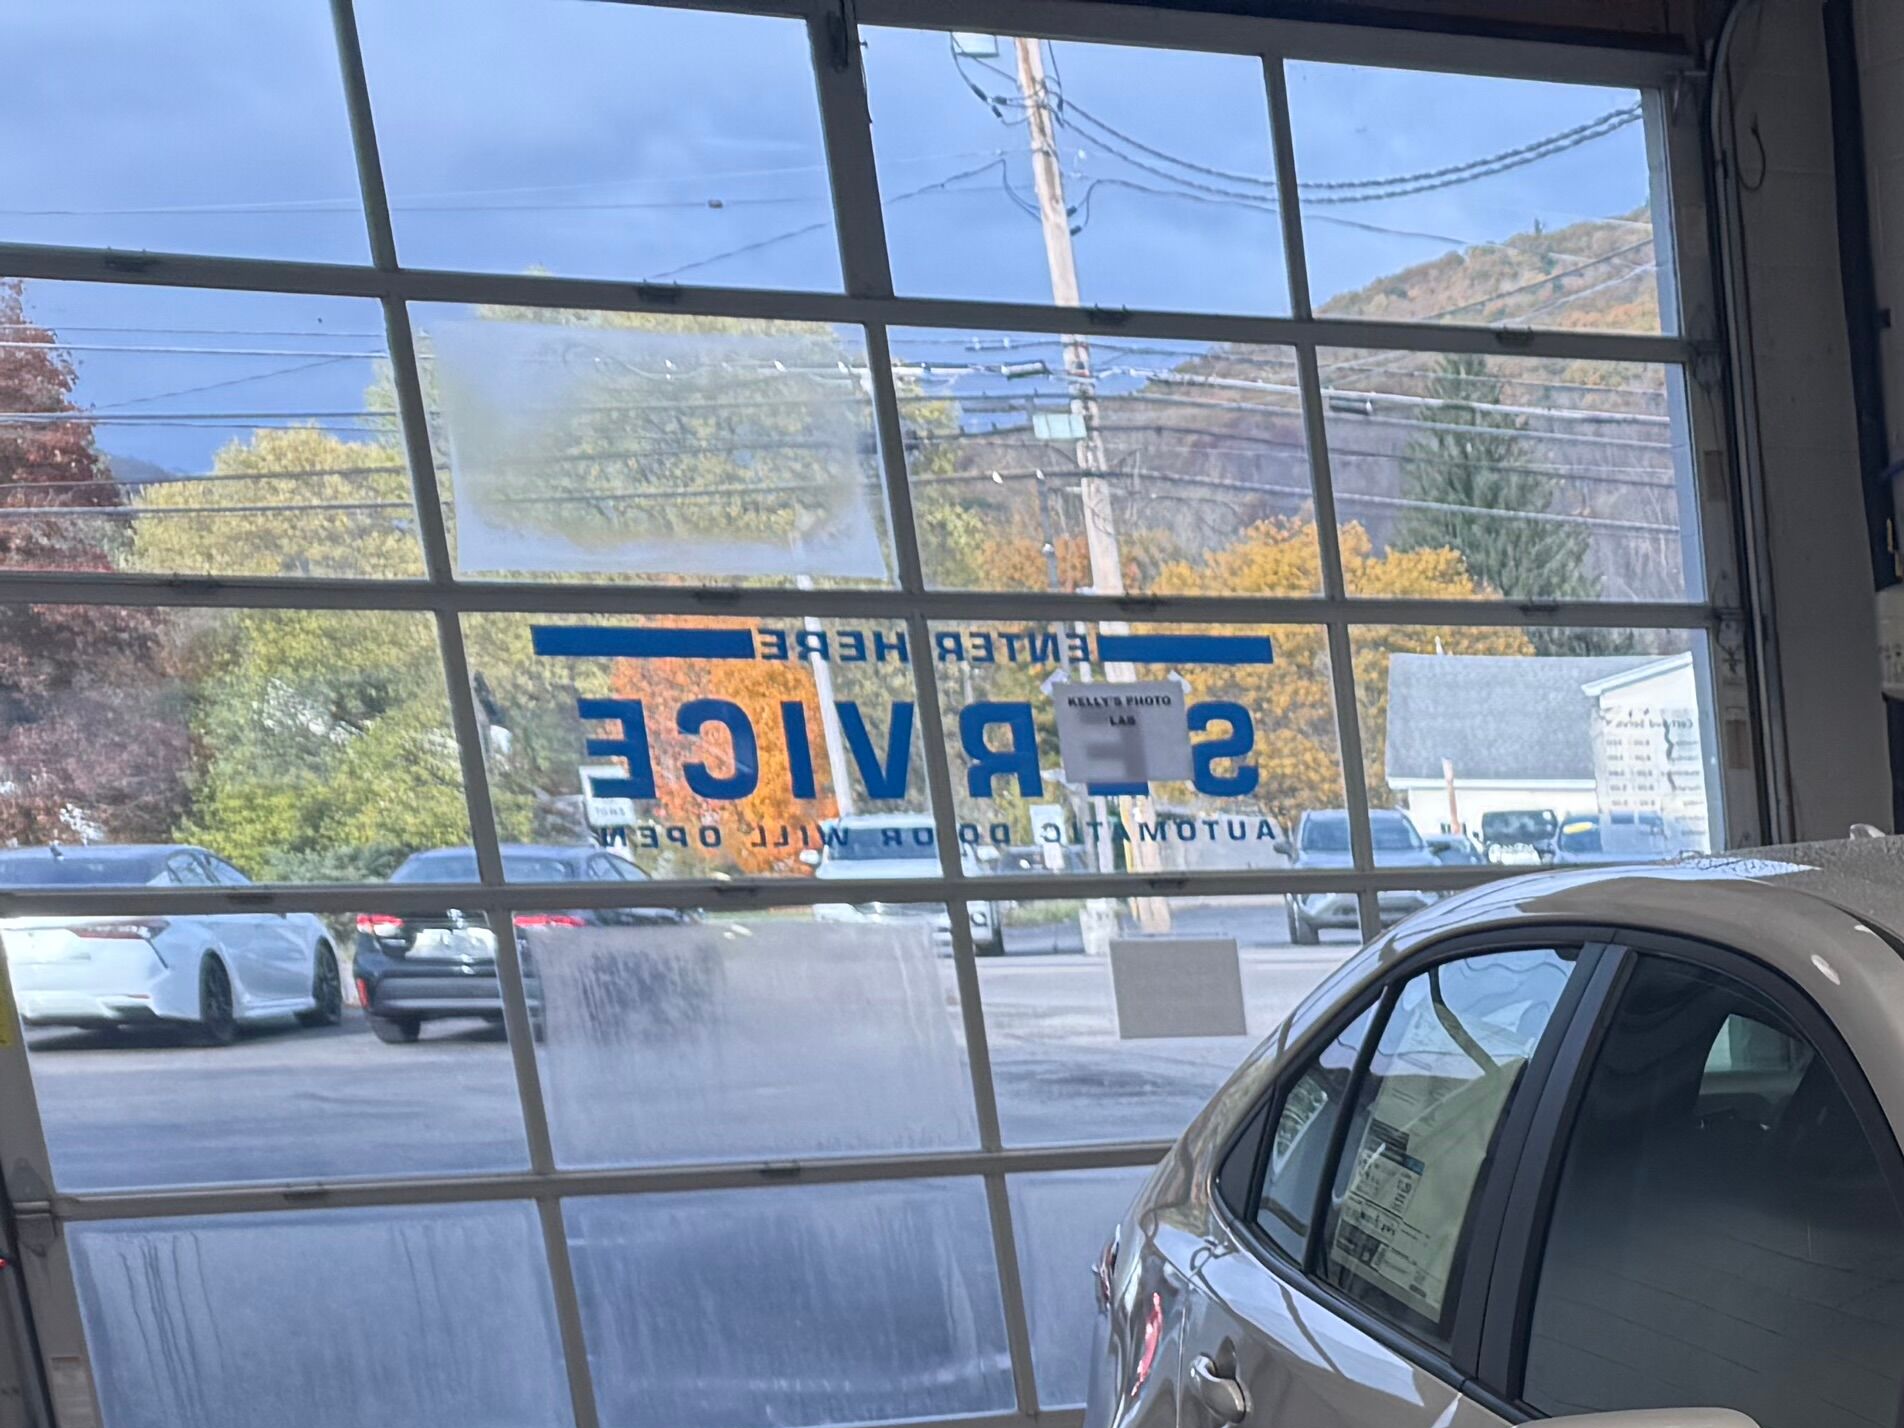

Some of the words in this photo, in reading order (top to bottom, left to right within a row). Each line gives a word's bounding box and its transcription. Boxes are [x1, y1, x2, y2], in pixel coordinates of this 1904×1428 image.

[1067, 695, 1122, 708] KELLY'S
[1125, 695, 1172, 706] PHOTO
[1109, 715, 1136, 727] LAB
